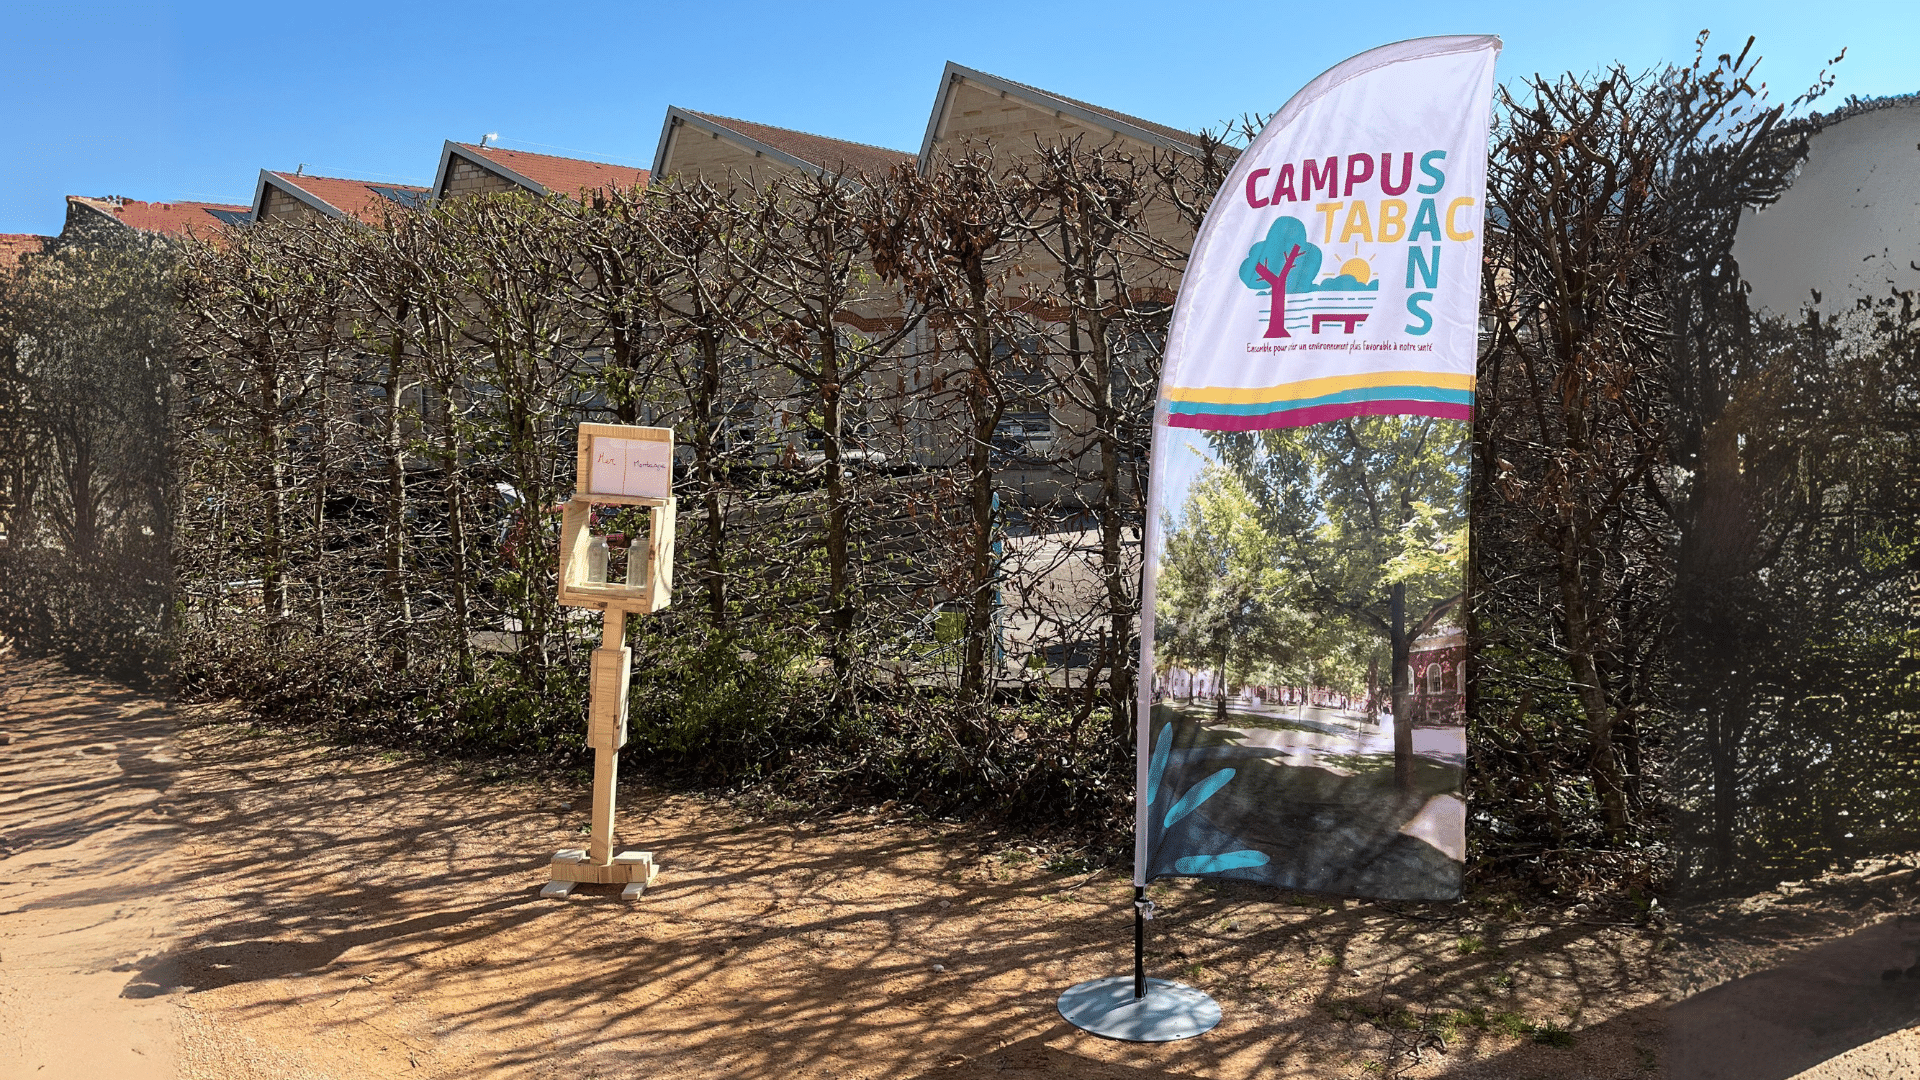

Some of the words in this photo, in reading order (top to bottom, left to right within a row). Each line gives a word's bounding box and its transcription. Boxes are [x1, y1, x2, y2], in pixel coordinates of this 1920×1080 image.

[1246, 150, 1447, 209] CAMPUS
[1316, 196, 1476, 244] TABAC
[1404, 150, 1447, 336] SANS
[1246, 342, 1272, 353] Ensemble
[1273, 345, 1288, 356] pour
[1308, 342, 1349, 351] environnement
[1349, 339, 1361, 355] plus
[1393, 341, 1398, 351] à
[1399, 342, 1416, 352] notre
[1417, 342, 1434, 352] santé
